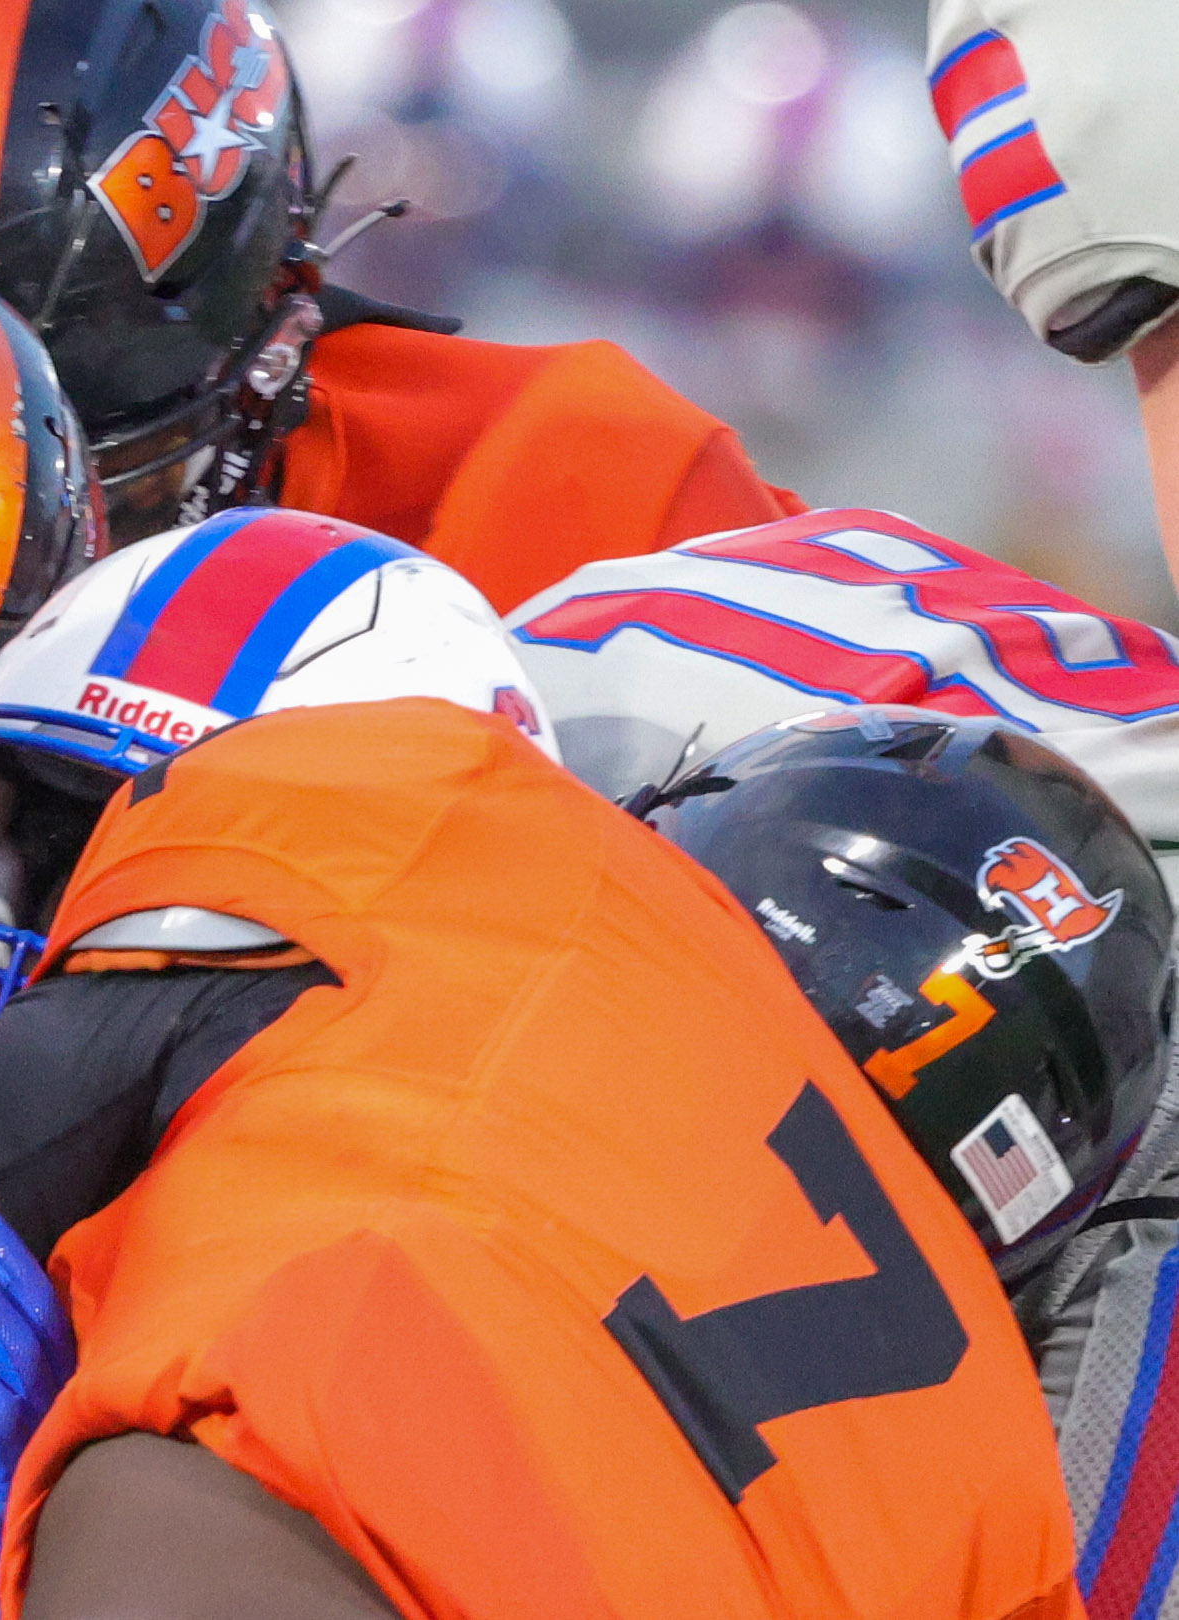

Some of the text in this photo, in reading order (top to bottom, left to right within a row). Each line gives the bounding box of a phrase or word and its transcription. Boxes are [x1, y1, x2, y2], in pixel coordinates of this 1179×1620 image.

[76, 682, 216, 746] Ridde
[863, 965, 997, 1101] 7
[600, 1079, 970, 1506] 7
